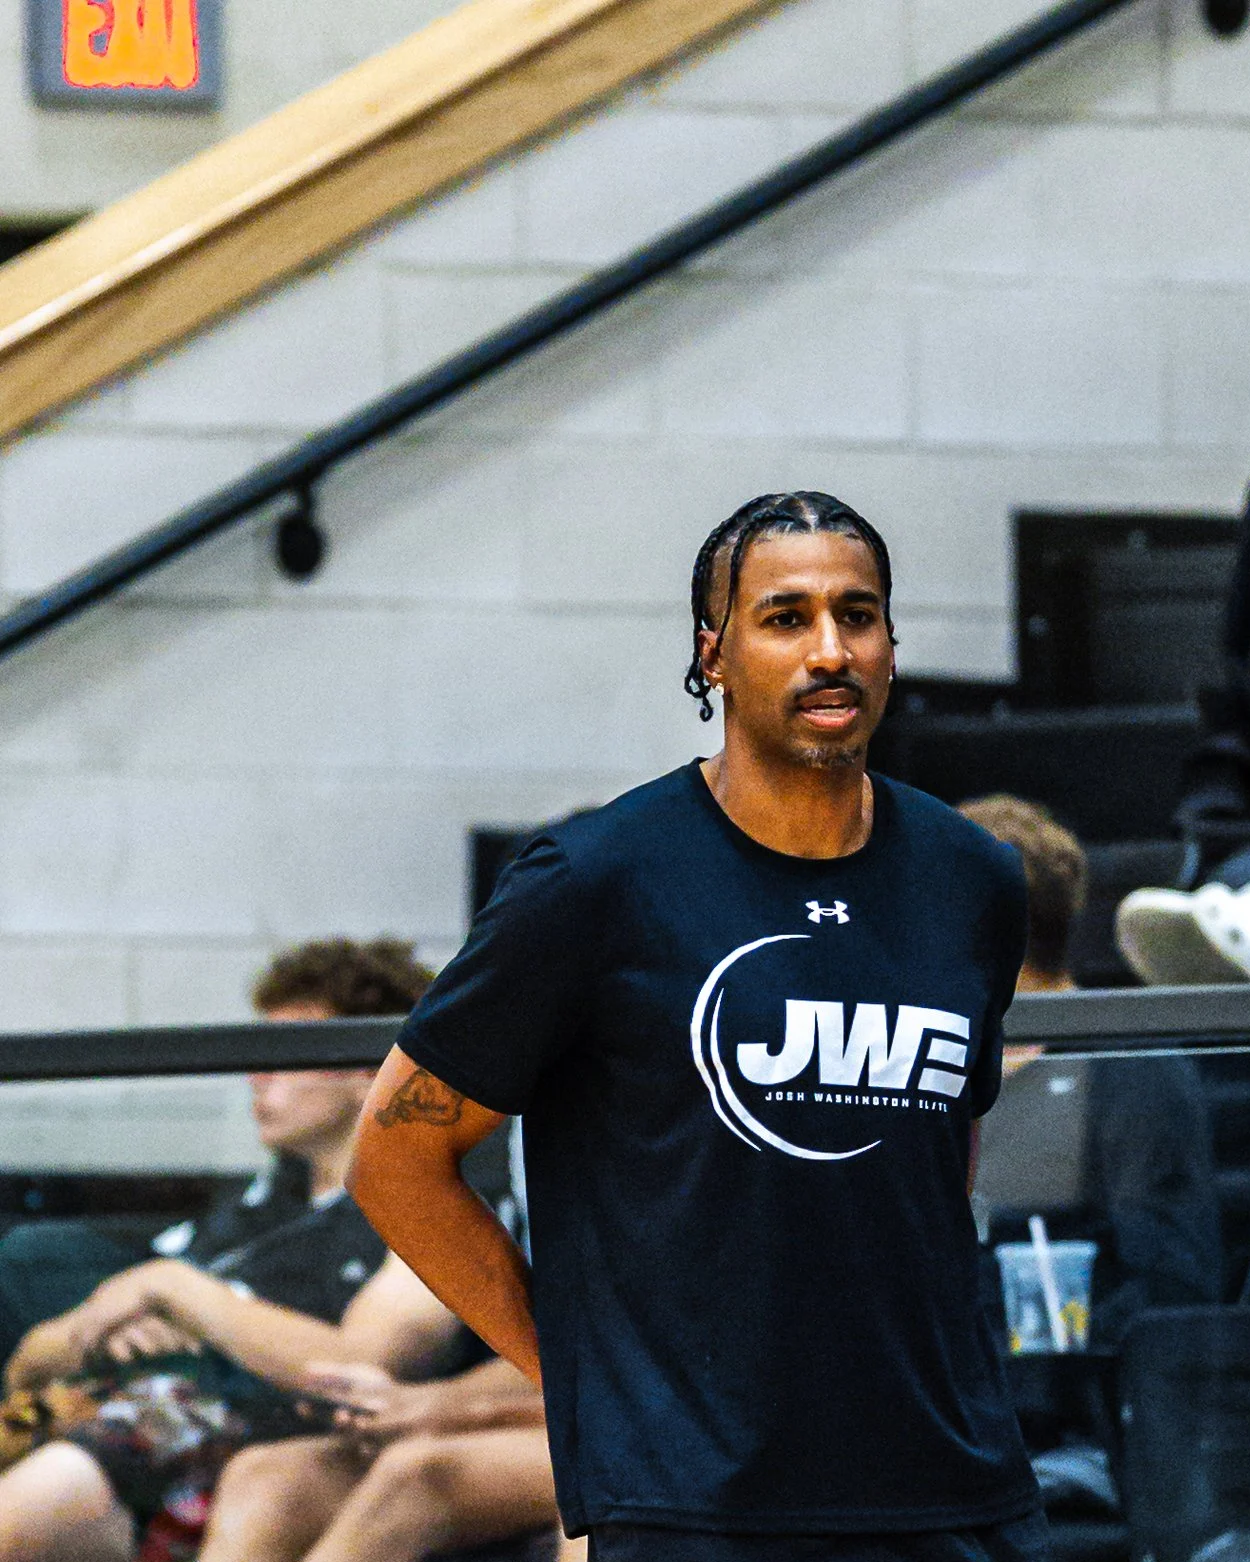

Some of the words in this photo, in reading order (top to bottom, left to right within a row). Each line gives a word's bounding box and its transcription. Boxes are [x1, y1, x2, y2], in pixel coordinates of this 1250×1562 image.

[736, 999, 970, 1098] JWE
[765, 1091, 805, 1102] JOSH
[814, 1093, 909, 1108] WASHINGTON
